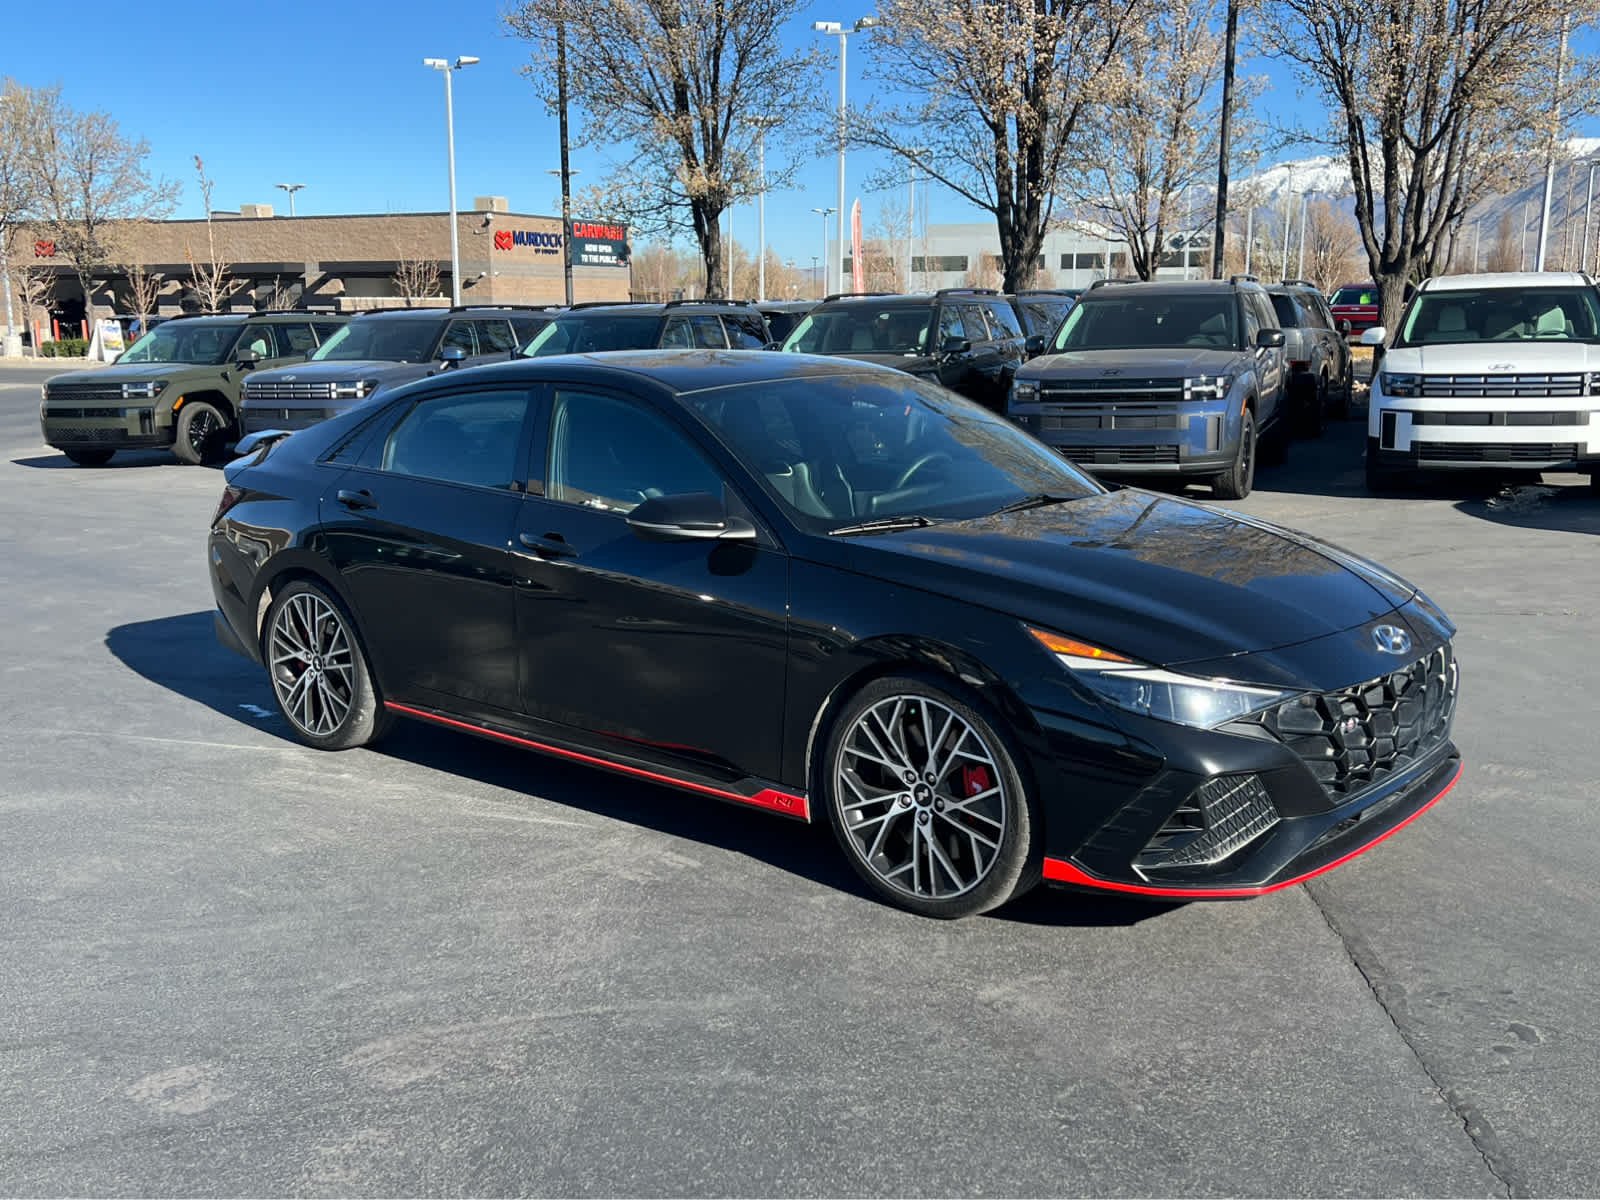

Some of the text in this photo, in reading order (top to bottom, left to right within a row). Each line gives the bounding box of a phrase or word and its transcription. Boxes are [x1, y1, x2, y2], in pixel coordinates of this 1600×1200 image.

[512, 230, 562, 248] MURDOCK
[581, 254, 617, 264] TO THE PUBLIC
